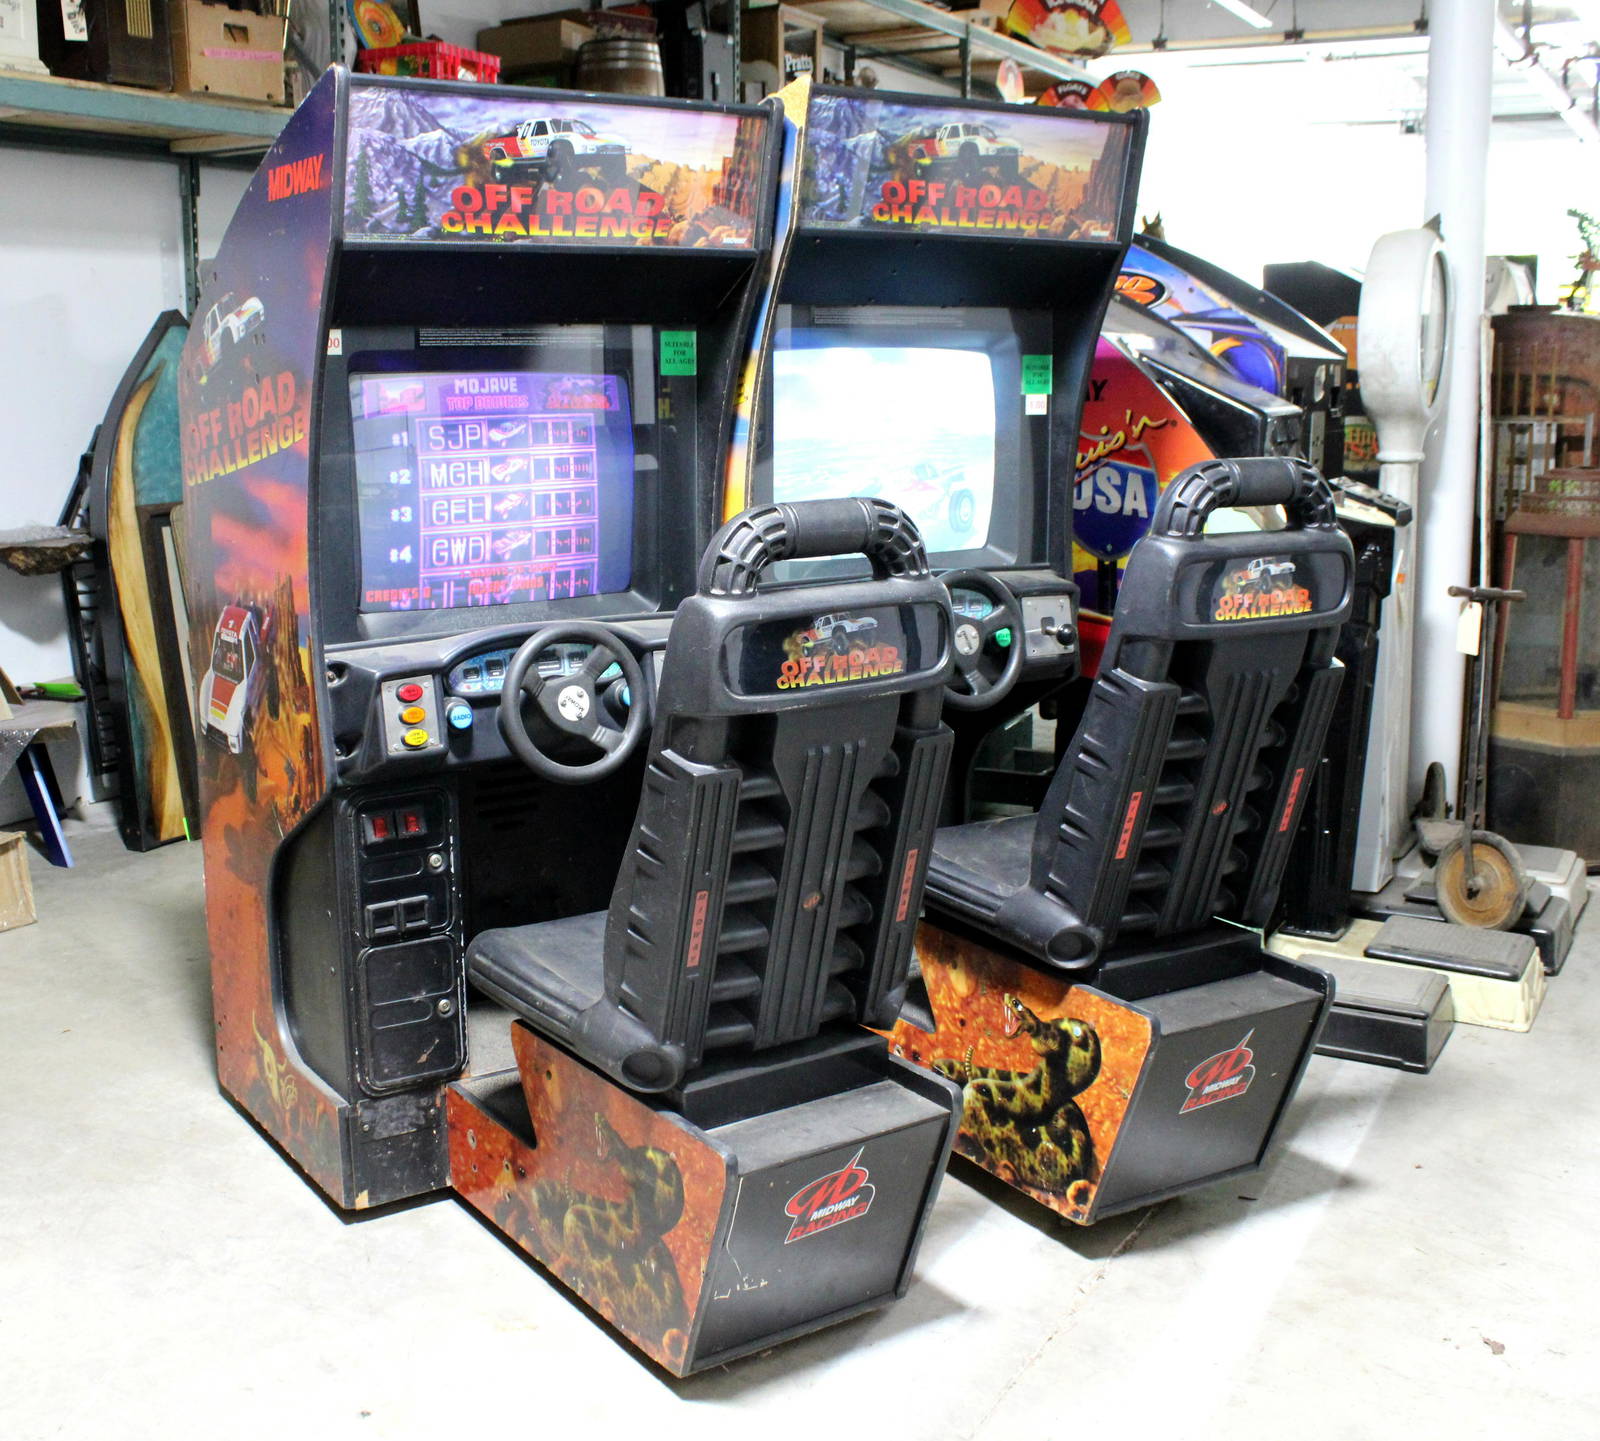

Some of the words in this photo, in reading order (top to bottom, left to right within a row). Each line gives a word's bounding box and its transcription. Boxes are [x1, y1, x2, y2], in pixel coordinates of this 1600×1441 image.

[267, 153, 323, 201] MIDWAY
[451, 184, 533, 213] OFF
[547, 187, 666, 217] ROAD
[881, 180, 946, 206] OFF
[955, 185, 1048, 211] ROAD
[441, 212, 672, 237] CHALLENGE
[872, 203, 1052, 230] CHALLENGE
[454, 377, 518, 394] MOJAVE
[187, 408, 222, 454] OFF
[227, 371, 295, 440] ROAD
[184, 408, 305, 487] CHALLENGE
[428, 424, 481, 451] SJP
[430, 461, 483, 488] MGH
[1072, 467, 1148, 519] USA
[1215, 600, 1313, 621] CHALLENGE
[1219, 593, 1255, 610] OFF
[1258, 589, 1310, 608] ROAD
[776, 660, 904, 690] CHALLENGE
[781, 655, 826, 678] OFF
[832, 647, 898, 671] ROAD
[452, 712, 472, 722] RADIO
[1183, 1081, 1248, 1111] RACING
[1202, 1074, 1243, 1095] MIDWAY
[788, 1202, 868, 1240] RACING
[810, 1194, 861, 1221] MIDWAY
